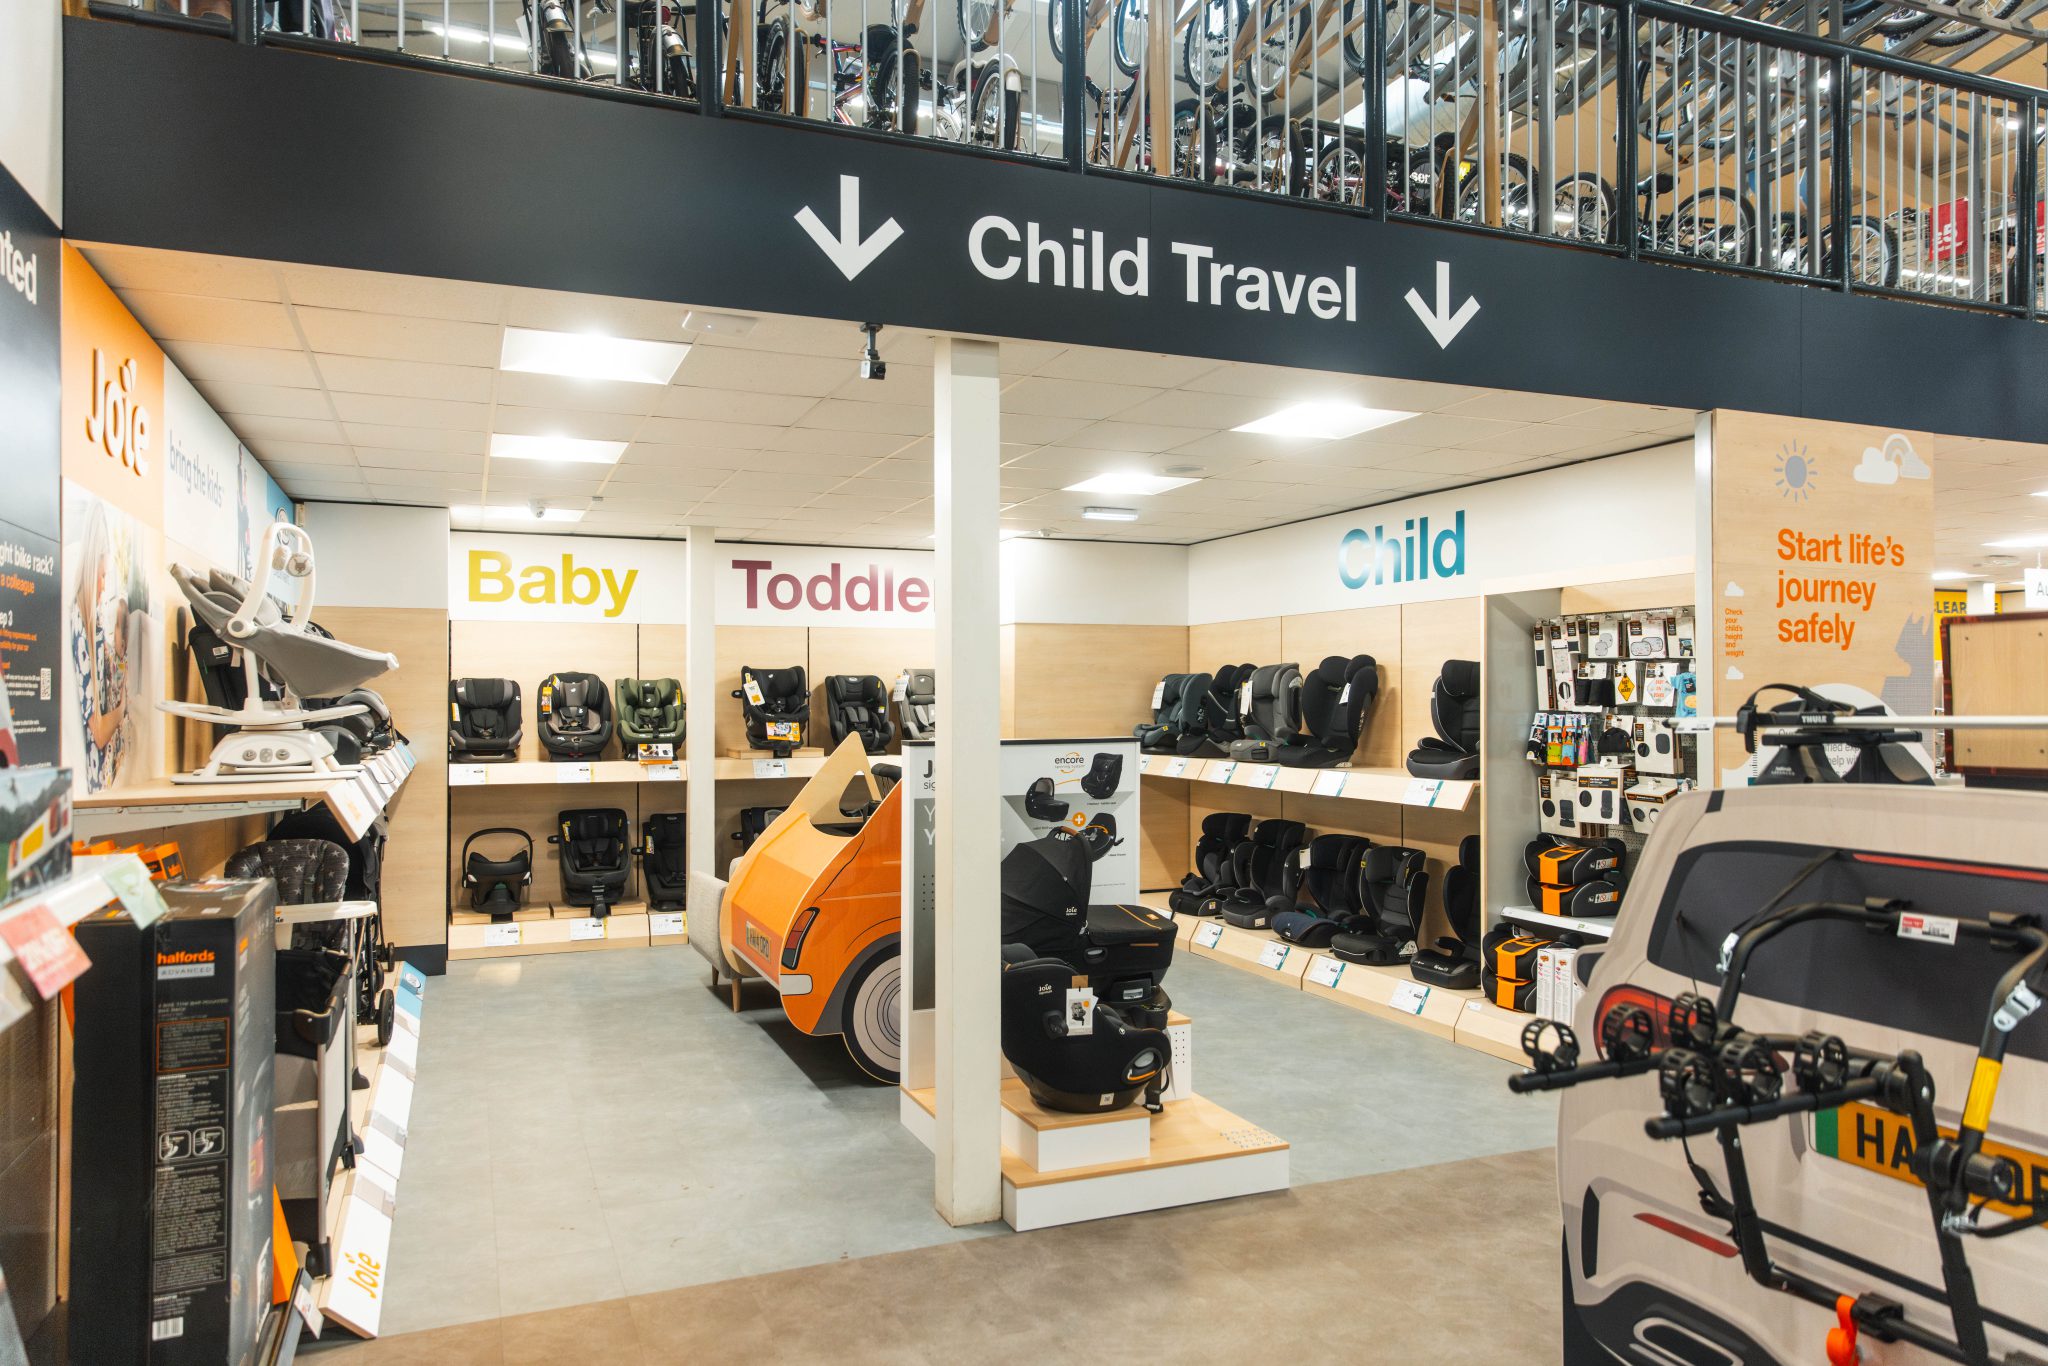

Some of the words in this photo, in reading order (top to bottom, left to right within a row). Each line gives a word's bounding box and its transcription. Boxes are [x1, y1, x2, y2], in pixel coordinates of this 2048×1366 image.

[968, 215, 1150, 298] Child
[1172, 241, 1359, 323] Travel
[86, 347, 149, 477] Joie
[169, 429, 192, 494] bring
[193, 454, 206, 496] the
[14, 544, 32, 570] bike
[33, 555, 54, 576] rack?
[1341, 510, 1466, 590] Child
[1777, 528, 1843, 564] Start
[1849, 534, 1905, 567] life's
[468, 549, 640, 618] Baby
[732, 559, 935, 613] Toddle
[1776, 570, 1877, 612] journey
[8, 610, 13, 627] 3
[1777, 611, 1857, 651] safely
[1055, 755, 1084, 765] encore
[157, 950, 216, 965] halfords
[160, 967, 212, 976] ADVANCED
[343, 1251, 381, 1300] Joie
